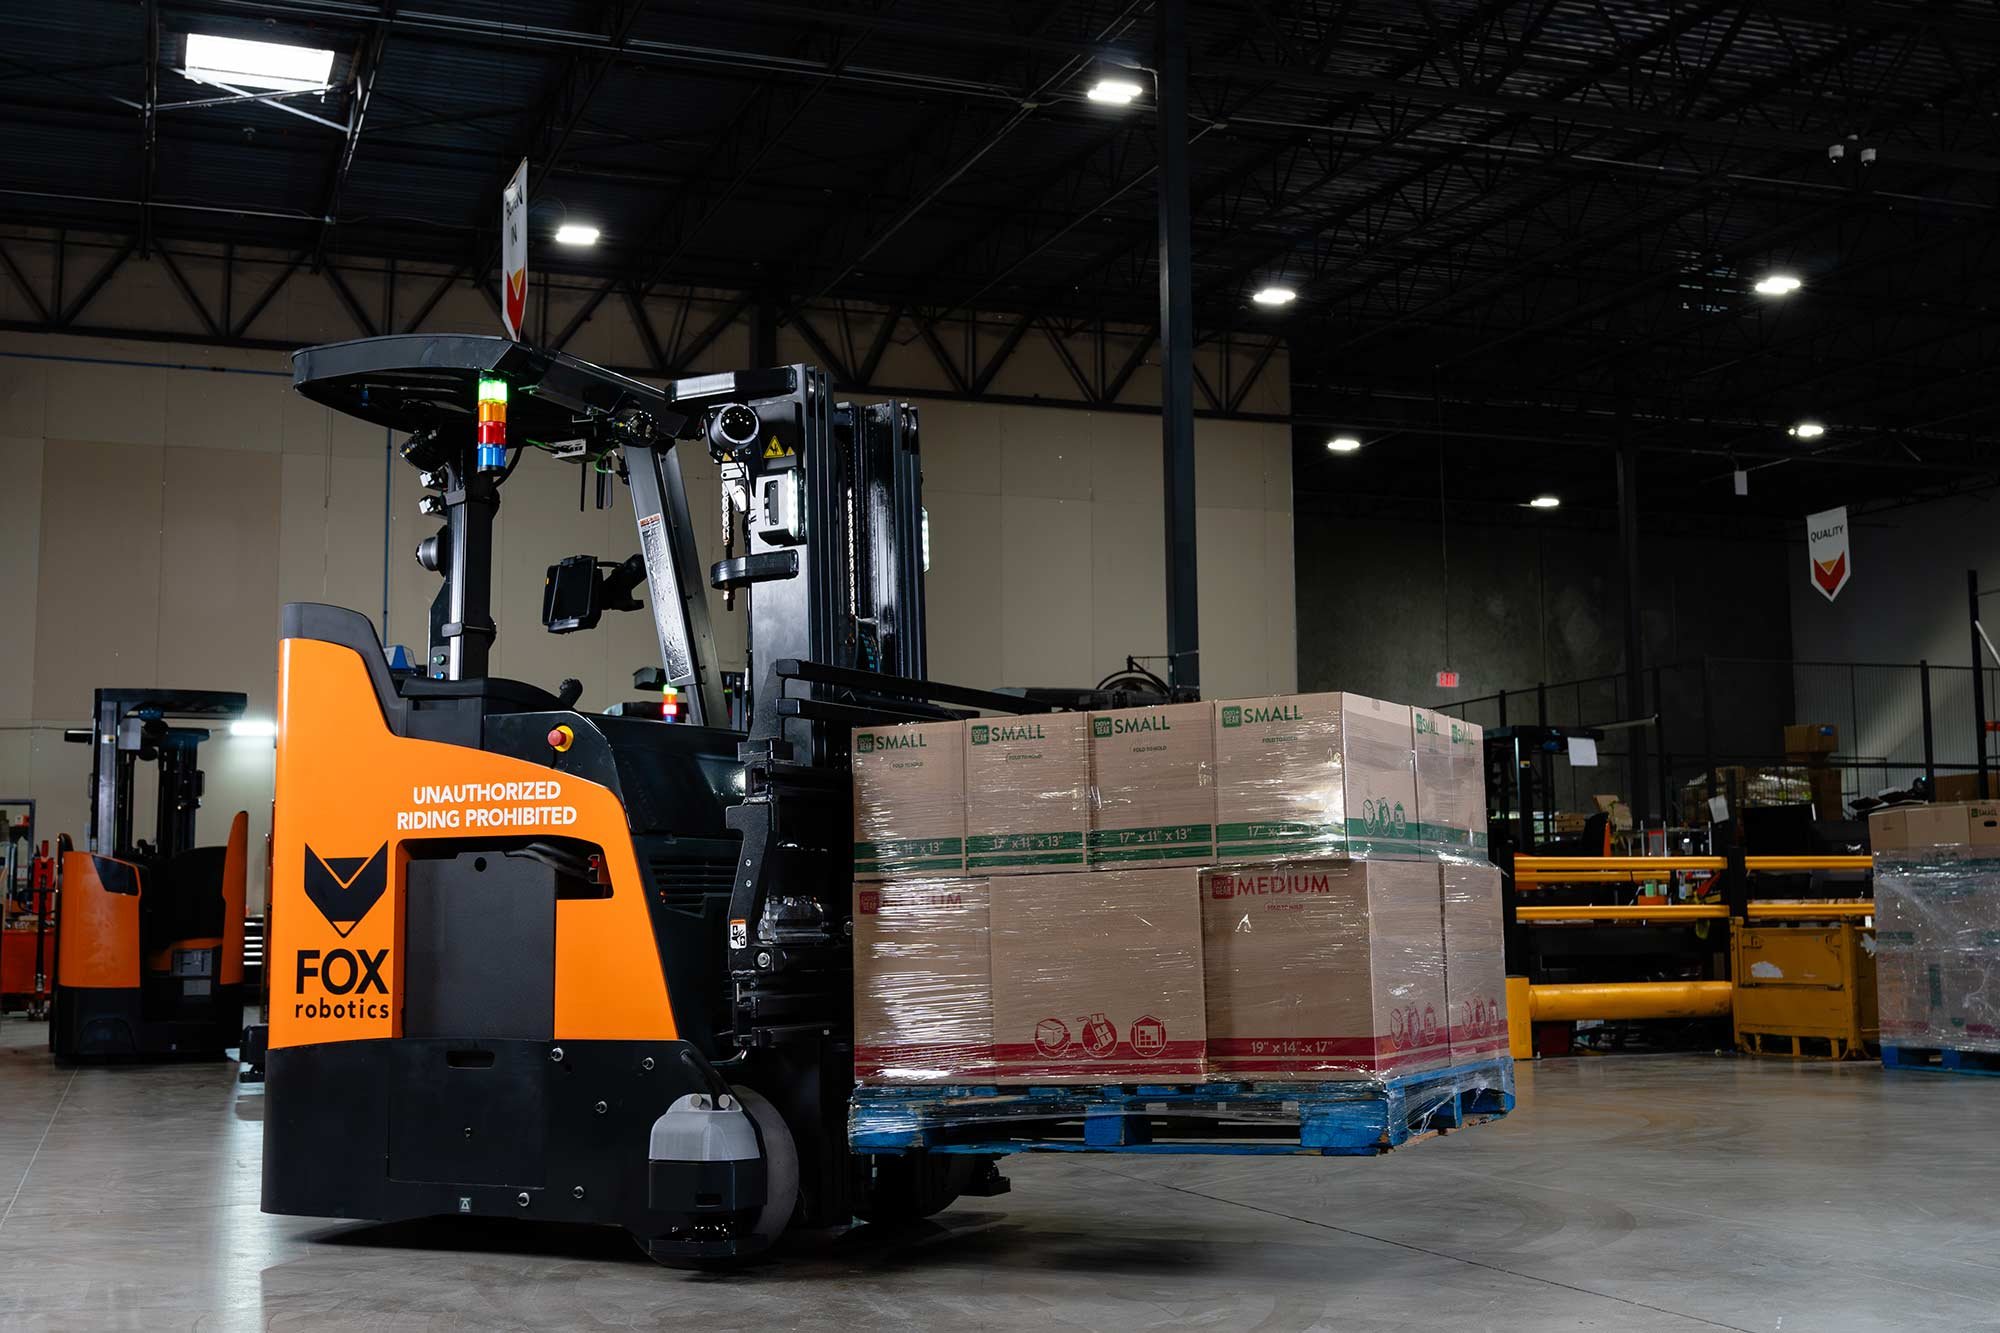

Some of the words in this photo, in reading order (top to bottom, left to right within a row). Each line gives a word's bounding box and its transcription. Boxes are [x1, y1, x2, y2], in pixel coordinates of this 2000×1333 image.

[1810, 525, 1844, 543] QUALITY
[1244, 704, 1303, 724] SMALL
[991, 724, 1046, 742] SMALL
[1114, 715, 1171, 734] SMALL
[876, 733, 928, 750] SMALL
[413, 781, 561, 804] UNAUTHORIZED
[397, 809, 460, 830] RIDING
[465, 806, 577, 827] PROHIBITED
[1119, 831, 1136, 844] 17"
[1138, 833, 1145, 842] x
[1147, 829, 1162, 842] 11"
[1165, 832, 1172, 841] x
[1175, 827, 1192, 841] 13"
[1248, 825, 1265, 838] 17"
[928, 840, 944, 853] 13"
[1012, 840, 1018, 849] x
[1038, 839, 1044, 847] x
[1047, 835, 1064, 847] 13"
[1237, 874, 1330, 896] MEDIUM
[296, 948, 390, 995] FOX
[295, 997, 389, 1019] robotics
[1251, 1041, 1269, 1054] 19"
[1272, 1045, 1280, 1053] x
[1283, 1041, 1302, 1053] 14"
[1305, 1044, 1313, 1053] x
[1315, 1040, 1334, 1053] 17"
